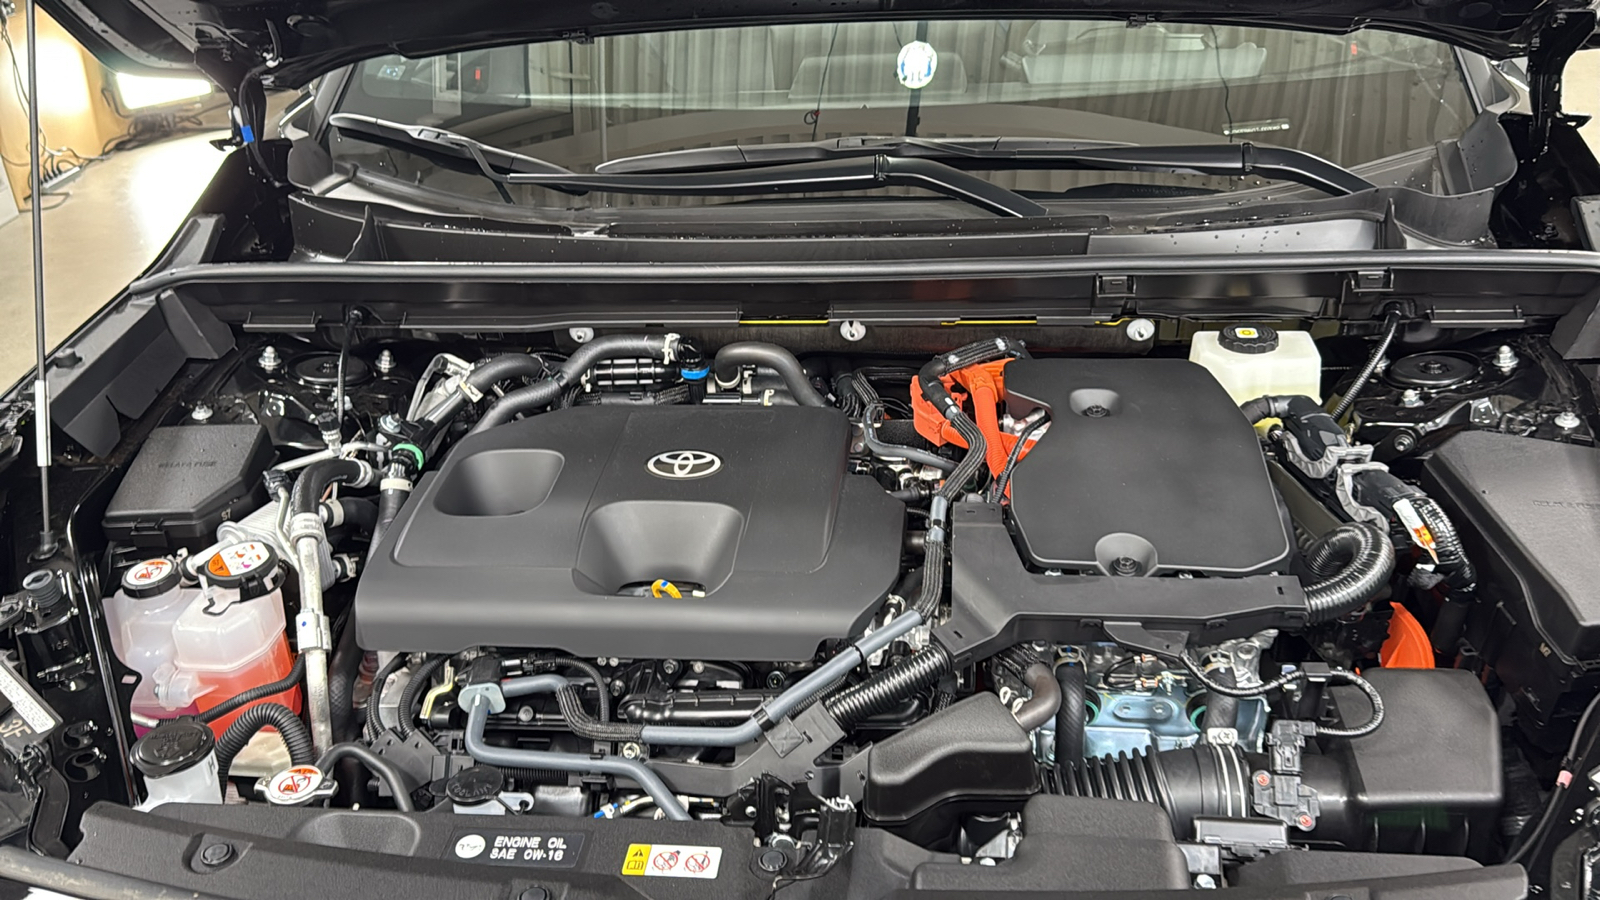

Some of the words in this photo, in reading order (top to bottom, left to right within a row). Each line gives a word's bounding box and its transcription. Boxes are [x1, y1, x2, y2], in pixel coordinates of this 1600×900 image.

[494, 835, 541, 848] ENGINE
[547, 837, 567, 849] OIL
[489, 847, 517, 860] SAE
